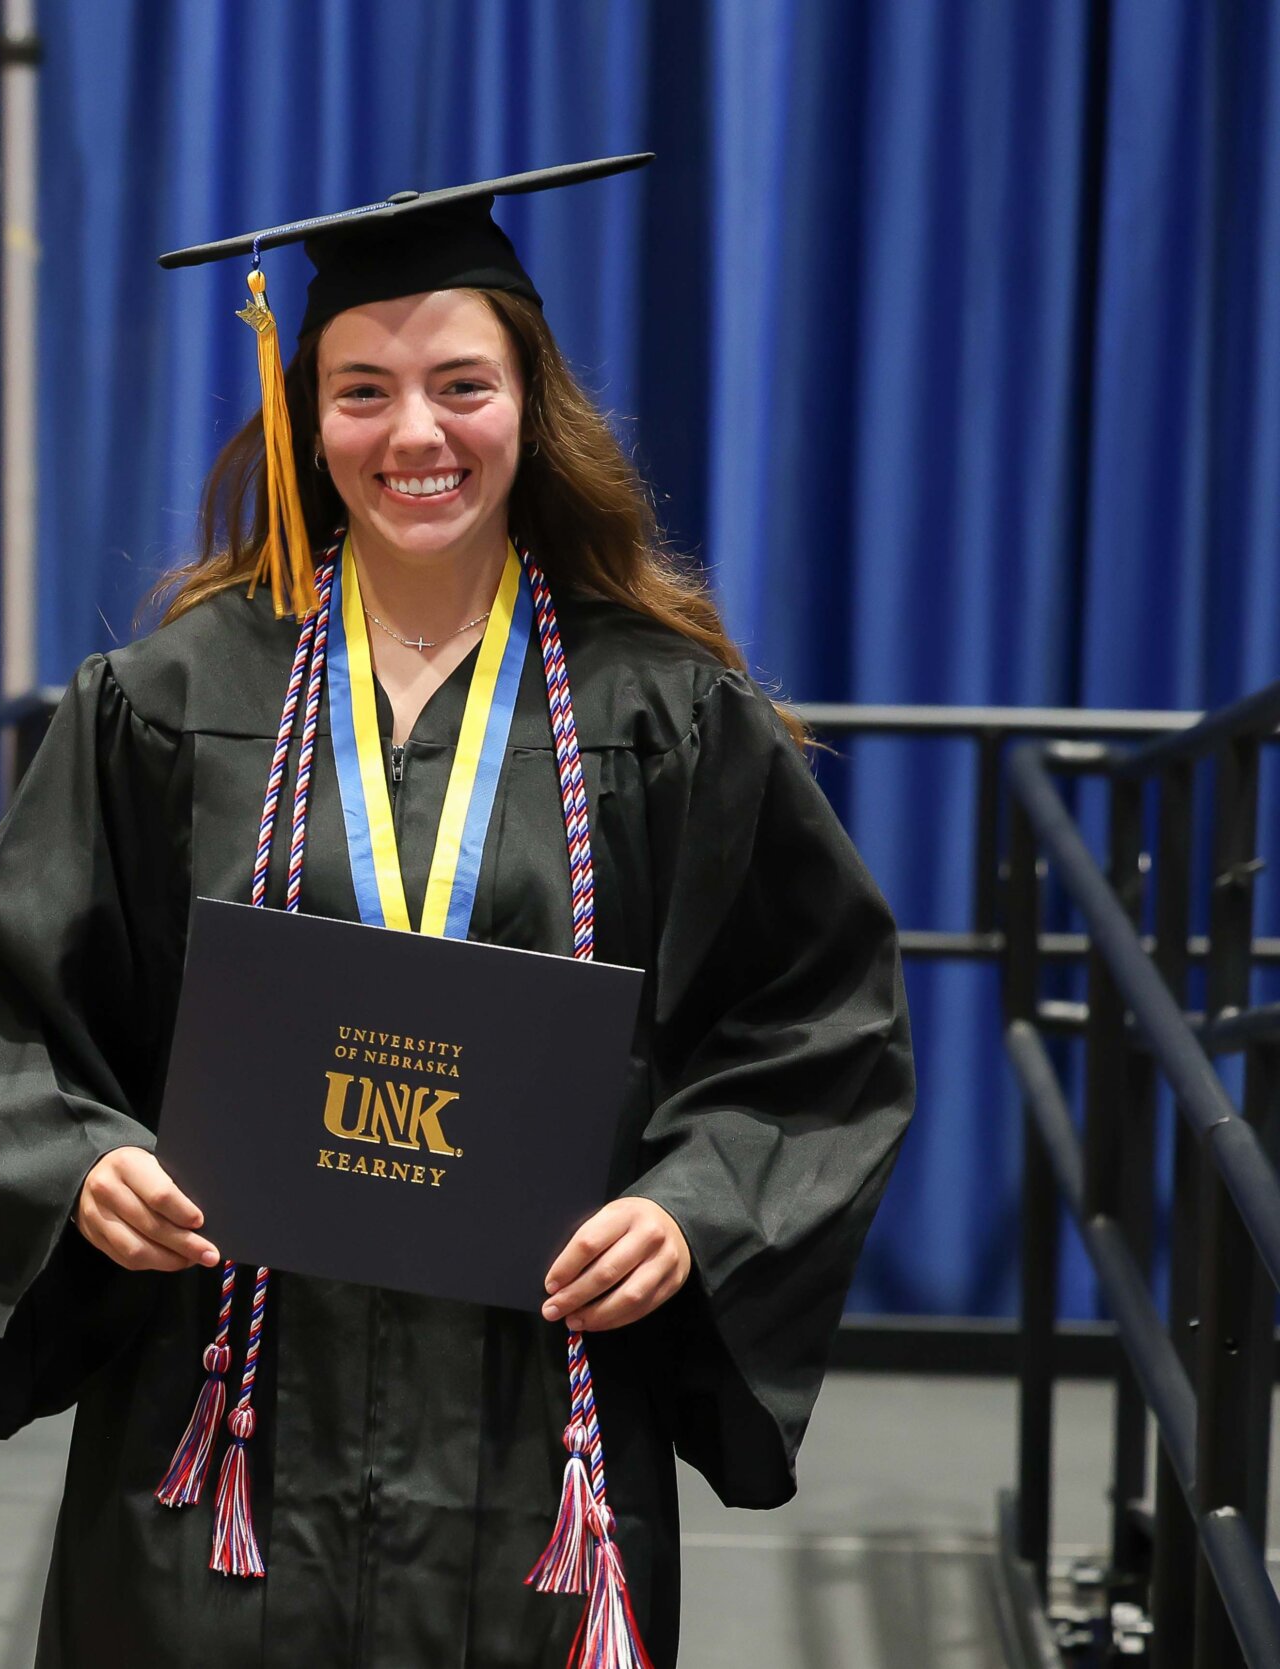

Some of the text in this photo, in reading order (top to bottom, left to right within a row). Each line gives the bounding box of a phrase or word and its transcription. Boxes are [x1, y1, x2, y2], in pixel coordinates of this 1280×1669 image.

[339, 1026, 463, 1058] UNIVERSITY
[335, 1045, 460, 1077] OF NEBRASKA
[323, 1071, 460, 1157] UNK
[317, 1149, 446, 1187] KEARNEY
